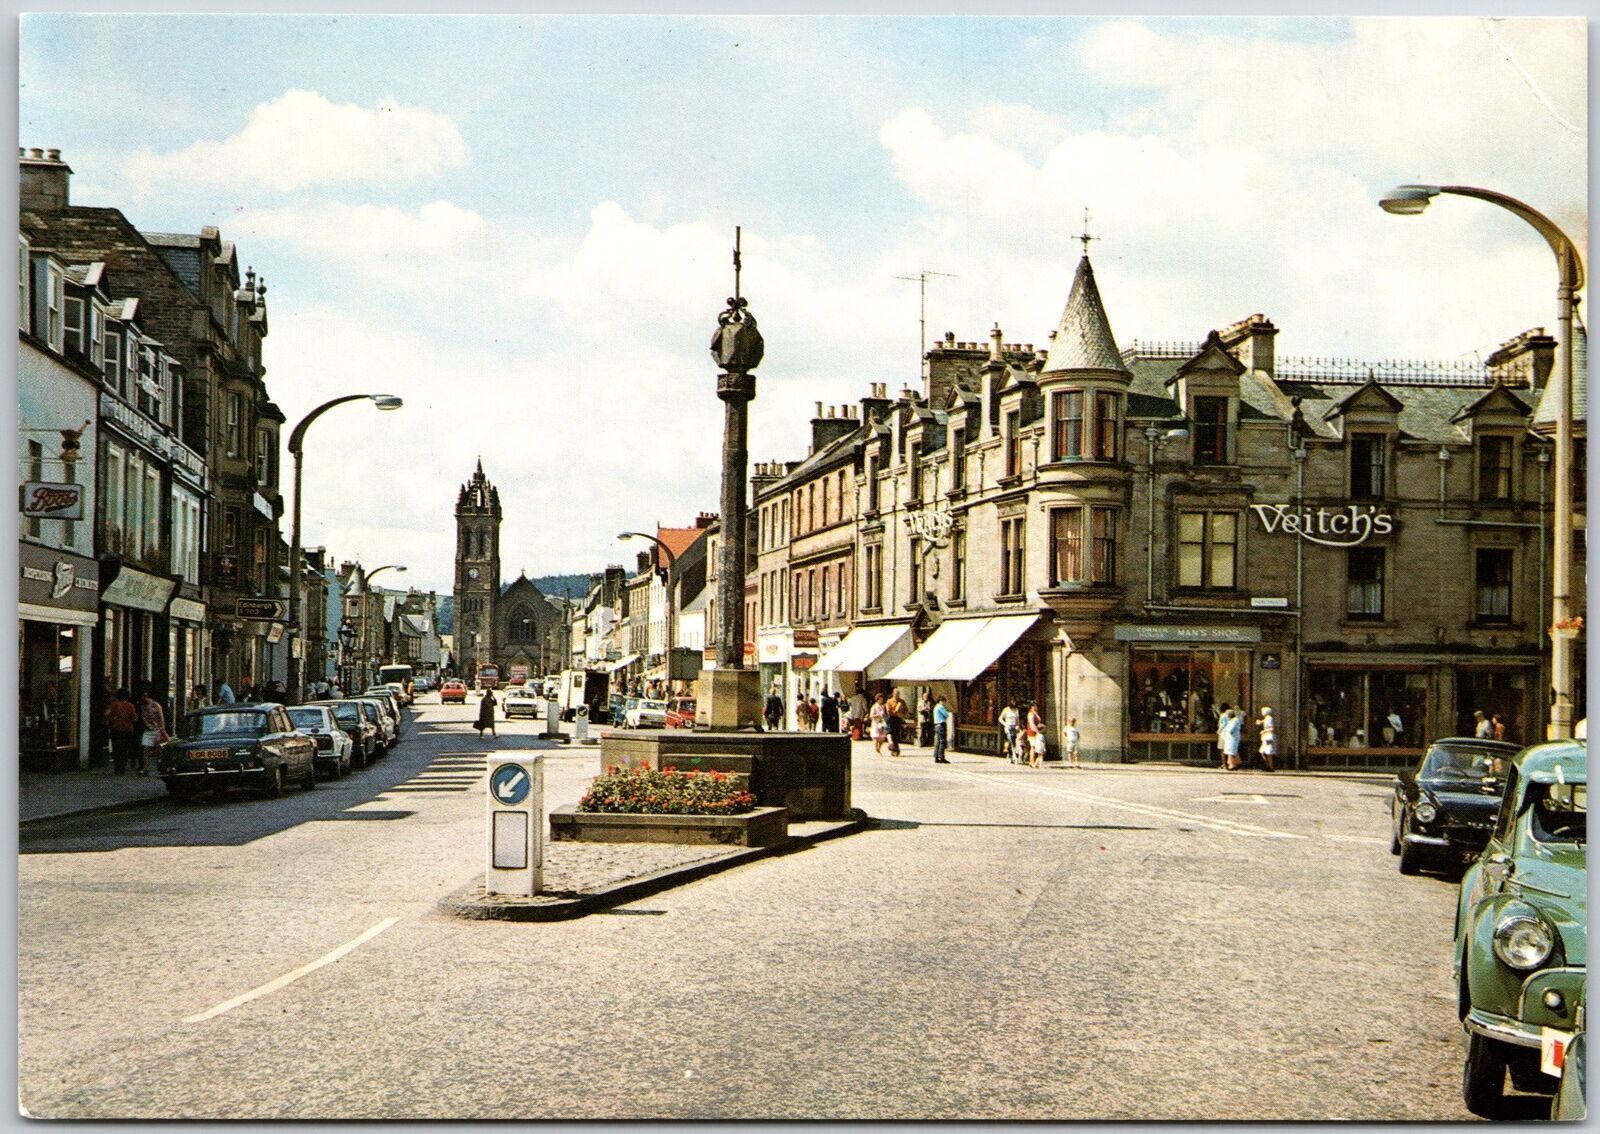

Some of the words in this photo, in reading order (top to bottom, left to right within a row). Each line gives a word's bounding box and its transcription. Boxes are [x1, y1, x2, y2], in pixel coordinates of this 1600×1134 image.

[26, 487, 79, 513] Boots
[1250, 504, 1393, 546] Veitch's
[1177, 628, 1208, 638] MAN'S
[1211, 629, 1240, 638] SHOP
